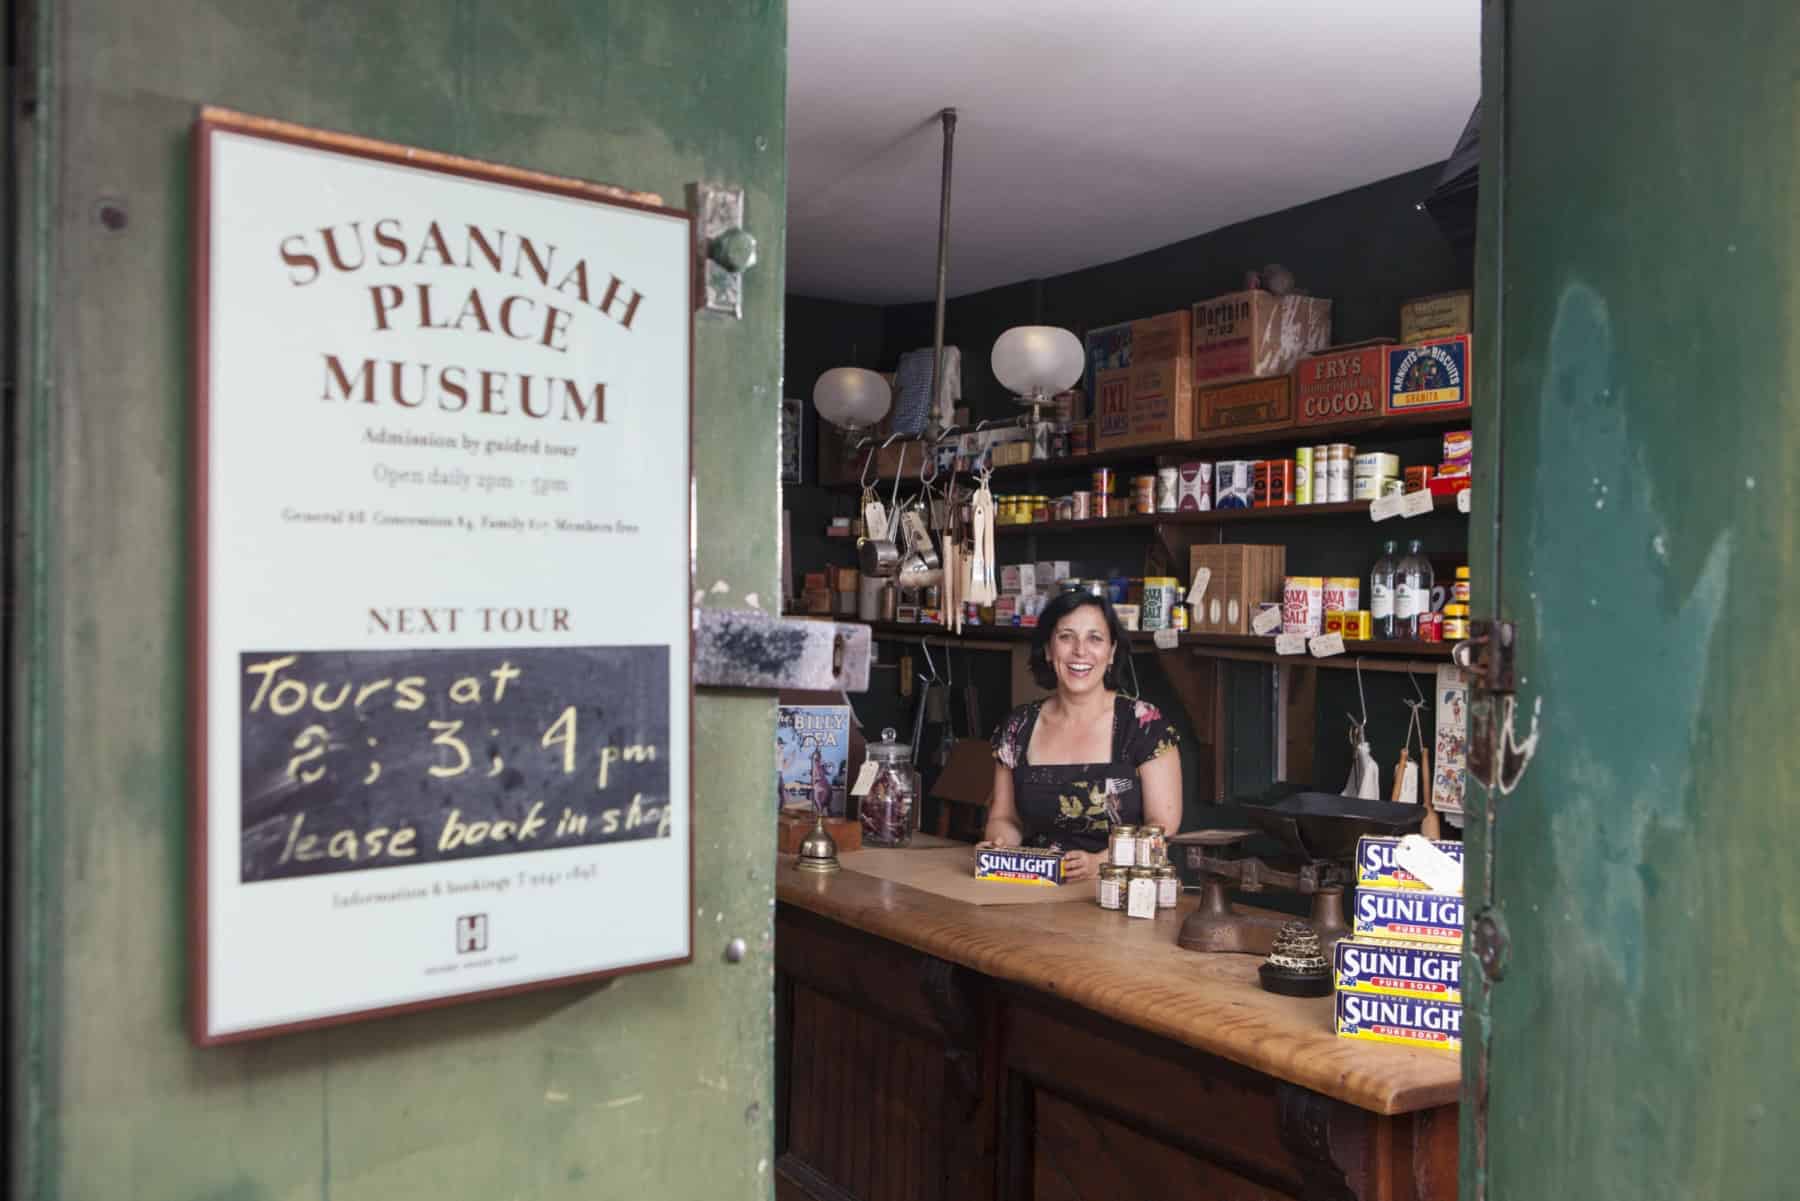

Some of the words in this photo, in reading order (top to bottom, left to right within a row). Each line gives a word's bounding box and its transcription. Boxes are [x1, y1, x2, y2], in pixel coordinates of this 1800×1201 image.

[279, 218, 646, 331] SUSANNAH
[368, 283, 575, 353] PLACE
[320, 353, 609, 424] MUSEUM
[1304, 391, 1375, 417] COCOA
[361, 426, 458, 447] Admission
[461, 432, 481, 456] by
[485, 435, 541, 456] guided
[544, 441, 579, 457] tour
[372, 462, 425, 488] Open
[428, 466, 471, 491] daily
[1284, 590, 1309, 604] SAXA
[1323, 590, 1345, 607] SAXA
[368, 607, 464, 634] NEXT
[477, 606, 571, 634] TOUR
[1284, 610, 1308, 625] SALT
[246, 655, 427, 717] Tours
[448, 661, 521, 704] at
[794, 714, 843, 729] BILLY
[540, 705, 578, 774] 4
[598, 746, 656, 790] pm
[801, 732, 837, 746] TEA
[438, 801, 546, 852] book
[556, 805, 587, 834] in
[980, 854, 1056, 878] SUNLIGHT
[1396, 924, 1418, 933] PURE
[1427, 927, 1454, 936] SOAP
[1343, 948, 1462, 983] SUNLIGH
[1379, 980, 1405, 988] PURE
[1411, 983, 1437, 991] SOAP
[1344, 996, 1463, 1031] SUNLIGH
[1380, 1028, 1406, 1036] PURE
[1411, 1031, 1438, 1040] SOAP
